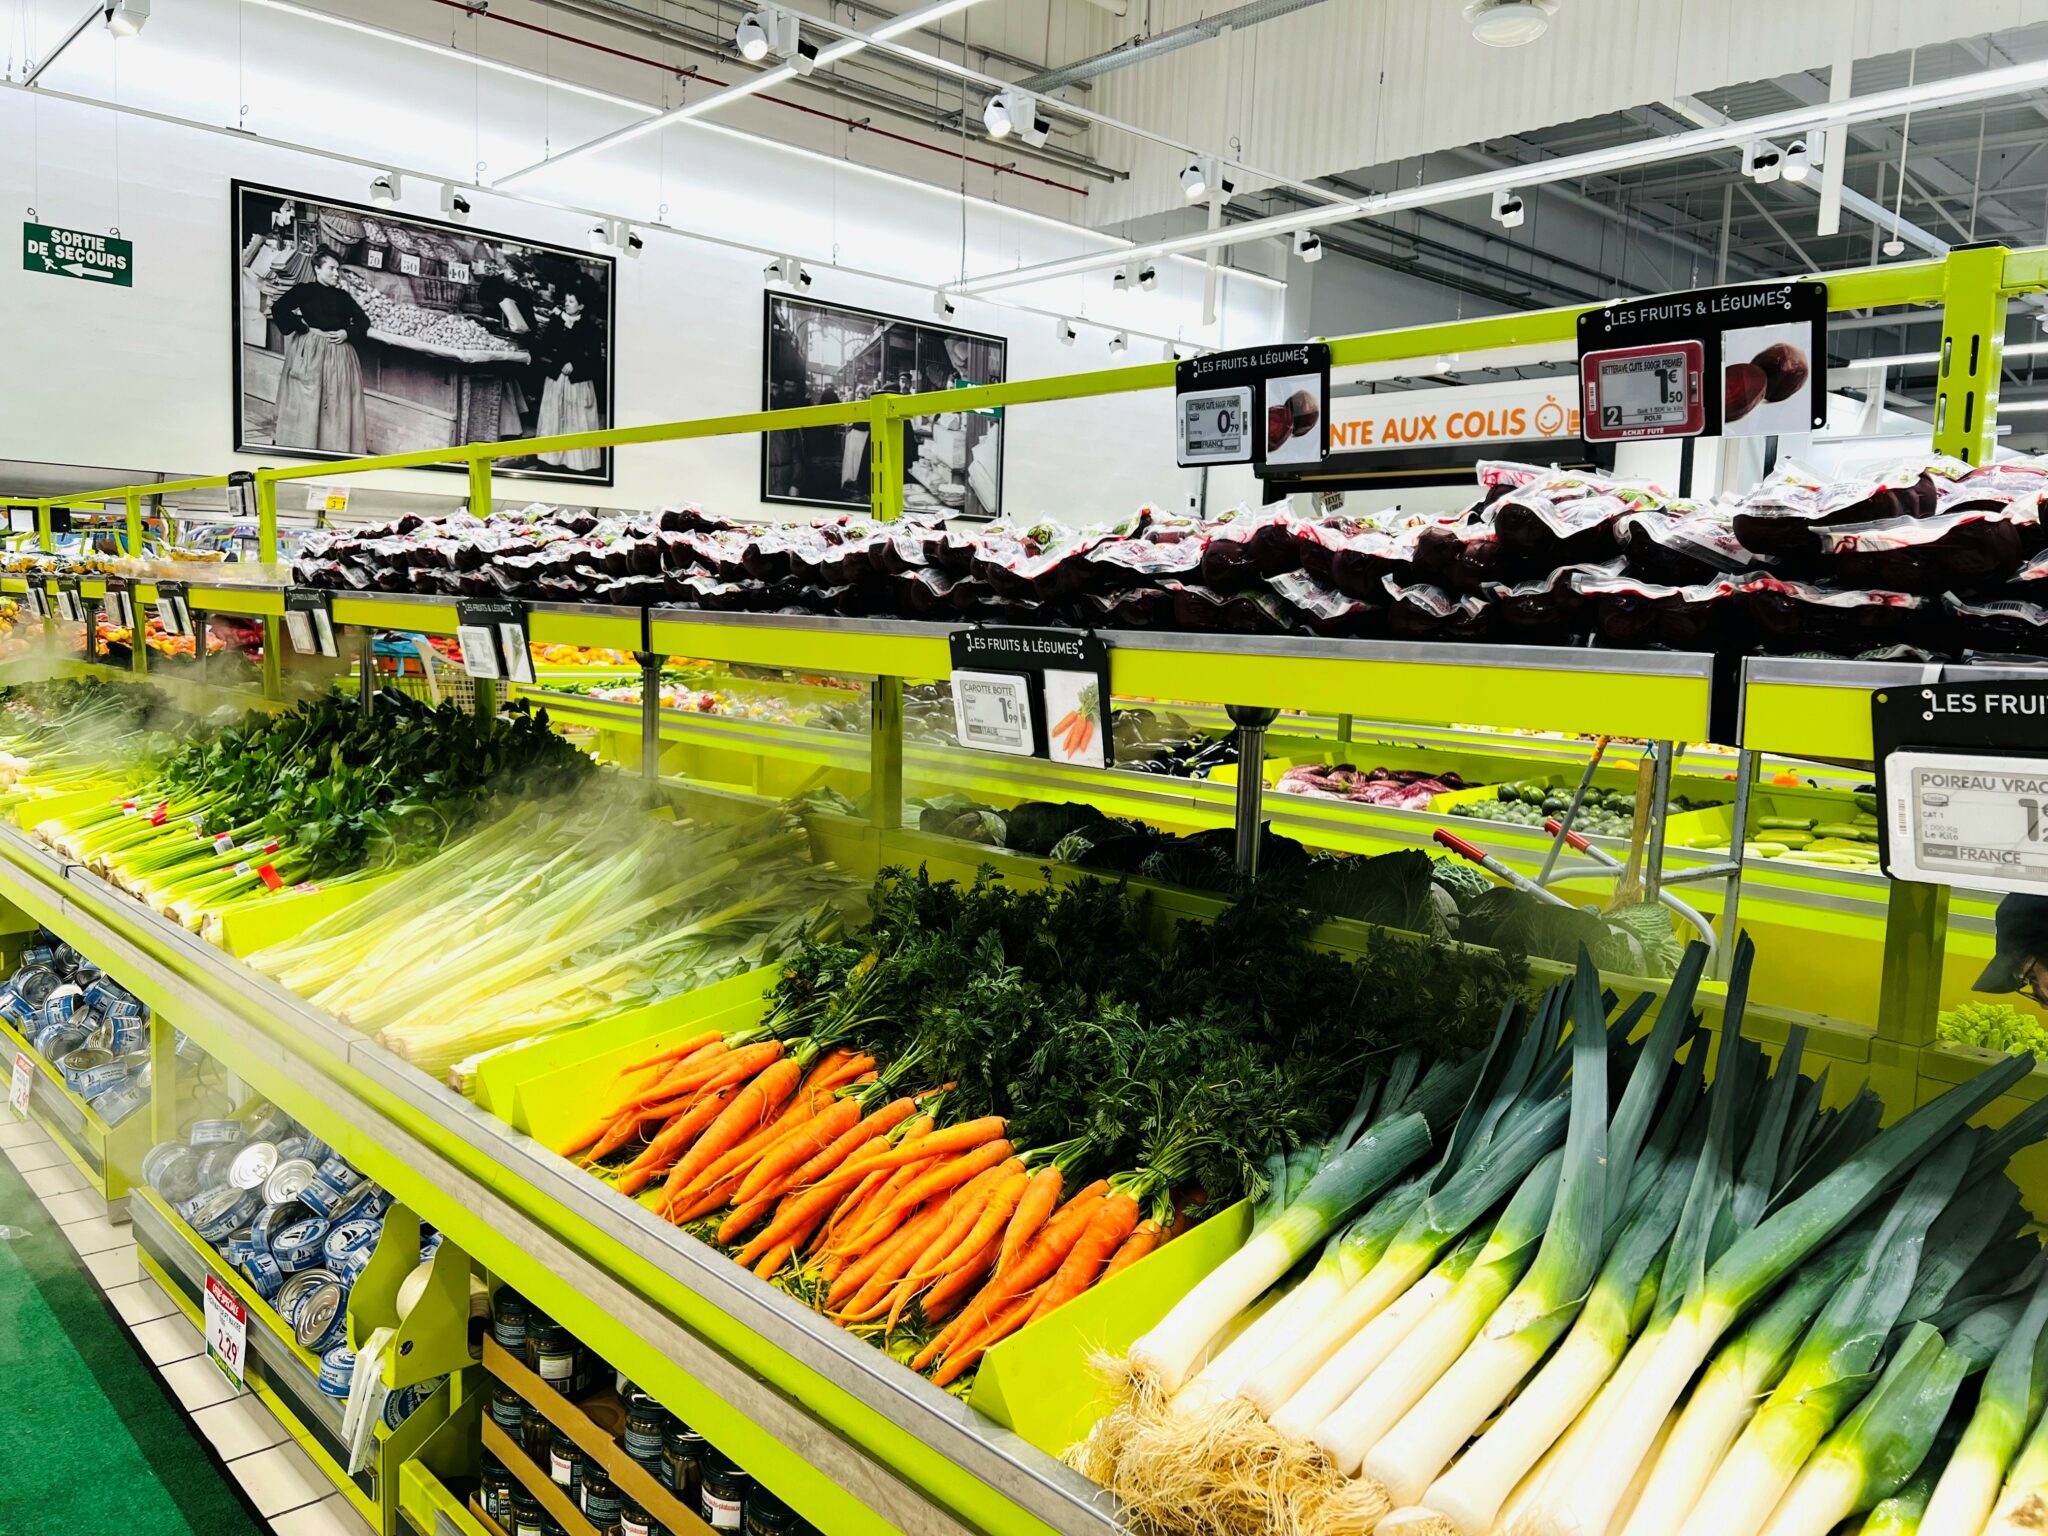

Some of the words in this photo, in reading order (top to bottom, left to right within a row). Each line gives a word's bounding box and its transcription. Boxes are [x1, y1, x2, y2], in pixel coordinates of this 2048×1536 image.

[50, 229, 106, 252] SORTIE
[27, 239, 49, 256] DE
[54, 244, 127, 270] SECOURS
[1611, 309, 1637, 327] LES
[1640, 303, 1692, 321] FRUITS
[1696, 301, 1707, 315] &
[1711, 291, 1786, 313] LÉGUMES
[1197, 362, 1214, 374] LES
[1215, 356, 1249, 371] FRUITS
[1250, 355, 1258, 366] &
[1259, 349, 1306, 366] LÉGUMES
[1628, 362, 1643, 373] CUITE
[1668, 369, 1678, 383] €
[1654, 369, 1668, 404] 1
[1668, 391, 1683, 403] 50
[1217, 409, 1231, 434] 0
[1230, 410, 1236, 420] €
[1606, 406, 1620, 426] 2
[1644, 414, 1662, 422] POUR
[1229, 423, 1240, 433] 79
[1381, 414, 1437, 444] AUX
[1446, 407, 1526, 439] COLIS
[1622, 429, 1645, 437] ACHAT
[1202, 440, 1224, 449] FRANCE
[969, 637, 986, 650] LES
[987, 638, 1021, 652] FRUITS
[1022, 639, 1030, 652] &
[1032, 638, 1079, 655] LÉGUMES
[964, 683, 992, 694] CAROTTE
[992, 686, 1013, 696] BOTTE
[998, 697, 1009, 723] 1
[1007, 699, 1013, 709] €
[1931, 693, 1978, 713] LES
[1985, 694, 2048, 715] FRUI
[1008, 713, 1019, 724] 99
[1920, 773, 1996, 790] POIREAU
[2018, 798, 2039, 842] 1
[1924, 830, 1937, 839] Le
[1939, 831, 1959, 841] Kilo
[1960, 847, 2022, 865] FRANCE
